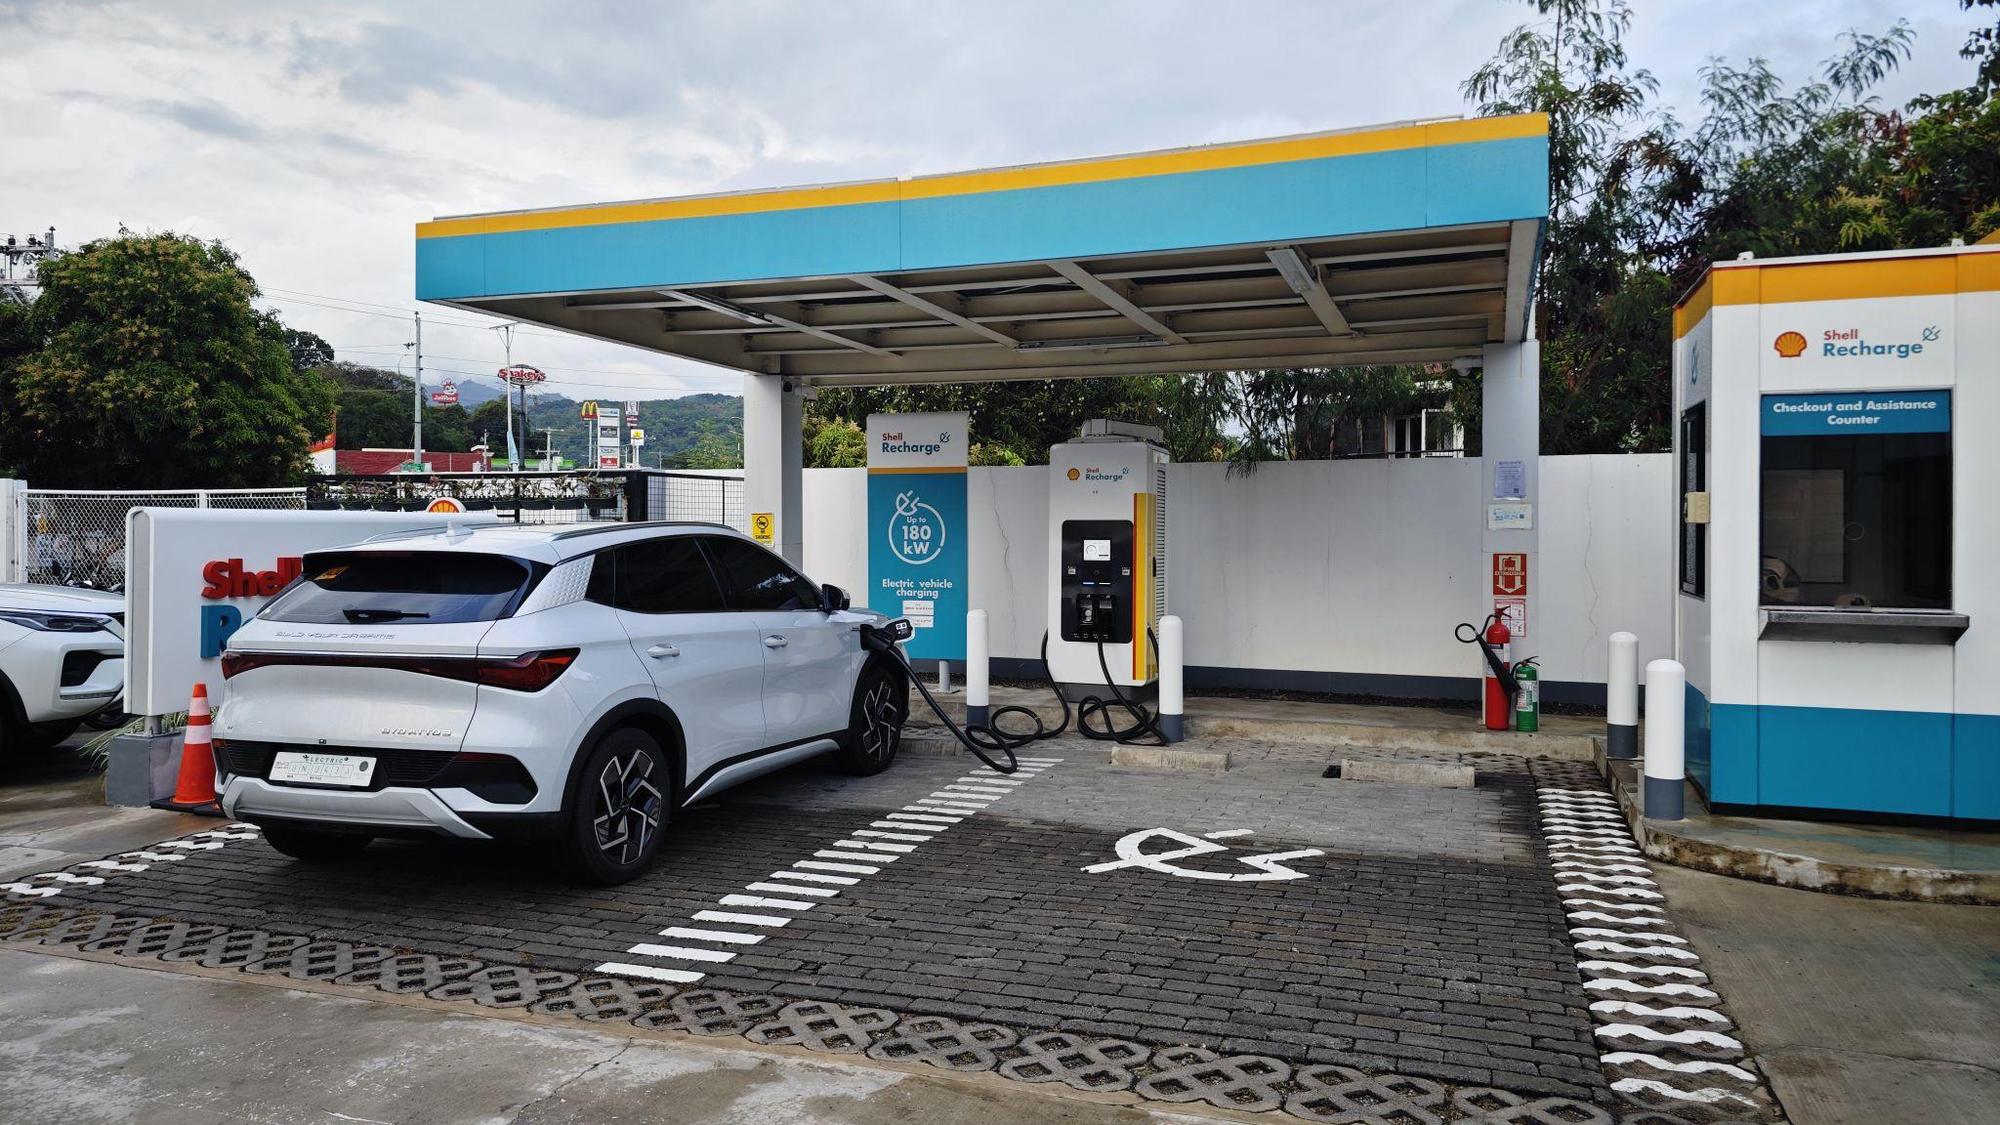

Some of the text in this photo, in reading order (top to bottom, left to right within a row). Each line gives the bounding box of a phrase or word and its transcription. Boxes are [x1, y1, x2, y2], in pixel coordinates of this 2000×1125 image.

[1824, 329, 1858, 340] Shell
[1823, 340, 1923, 358] Recharge
[1773, 400, 1937, 413] Checkout and Assistance
[1827, 415, 1880, 425] Counter
[882, 432, 903, 441] Shell
[882, 441, 941, 455] Recharge
[1085, 473, 1123, 482] Recharge
[906, 516, 917, 524] Up
[902, 525, 932, 540] 180
[903, 541, 930, 554] kW
[882, 579, 953, 588] Electric vehicle
[896, 588, 939, 599] charging
